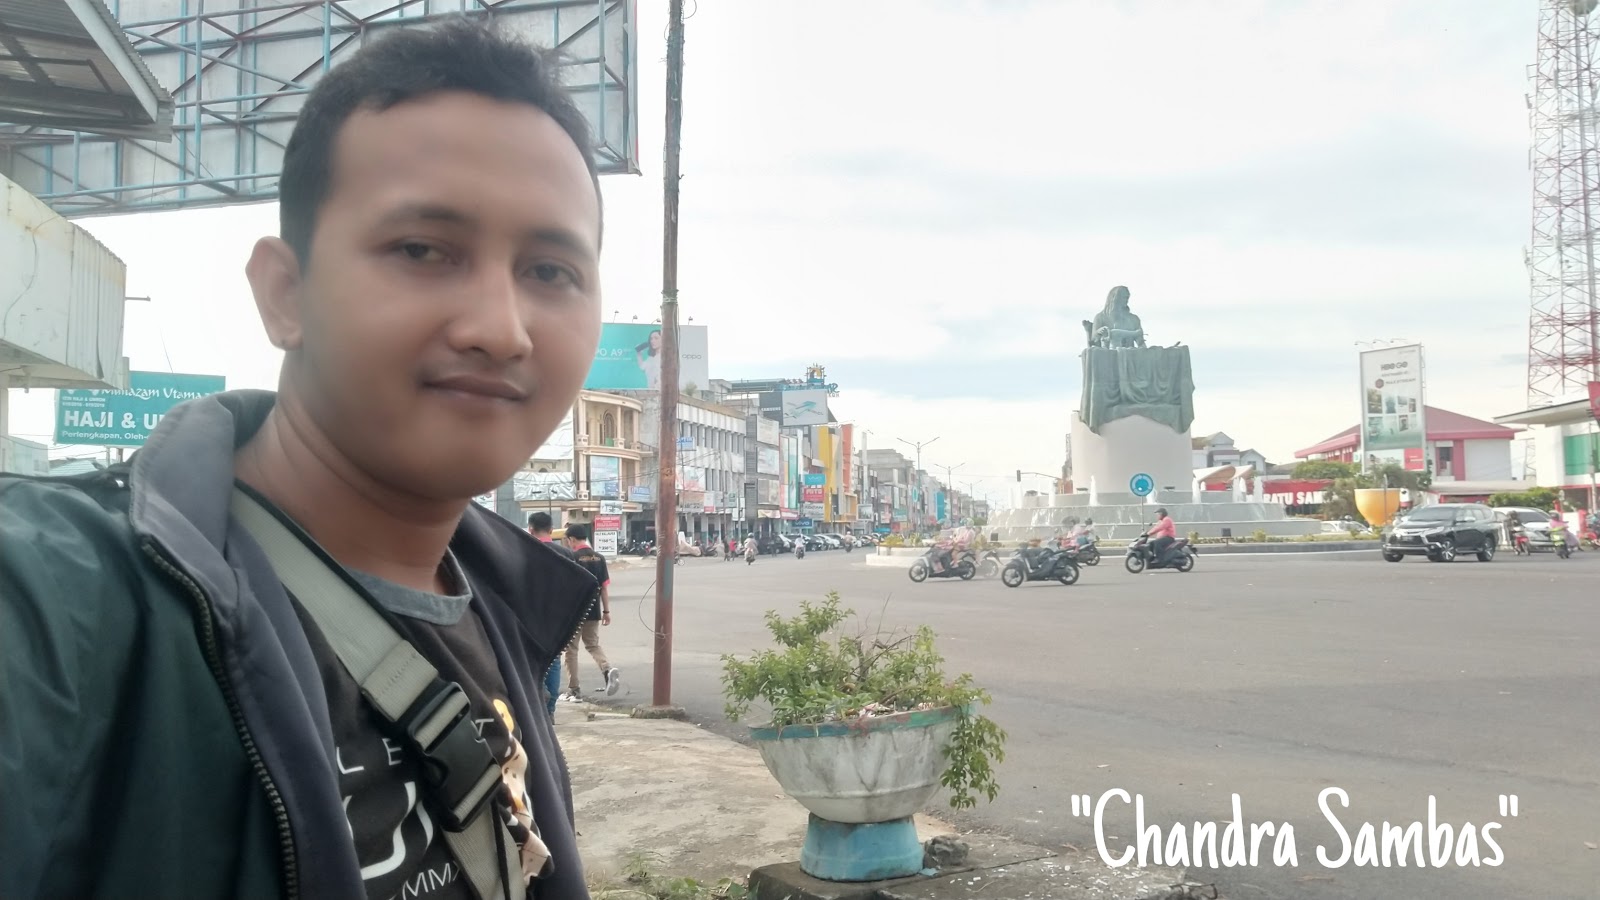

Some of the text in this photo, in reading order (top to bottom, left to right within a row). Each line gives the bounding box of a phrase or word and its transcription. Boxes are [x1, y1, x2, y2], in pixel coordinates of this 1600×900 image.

[64, 410, 165, 430] HAJI & U
